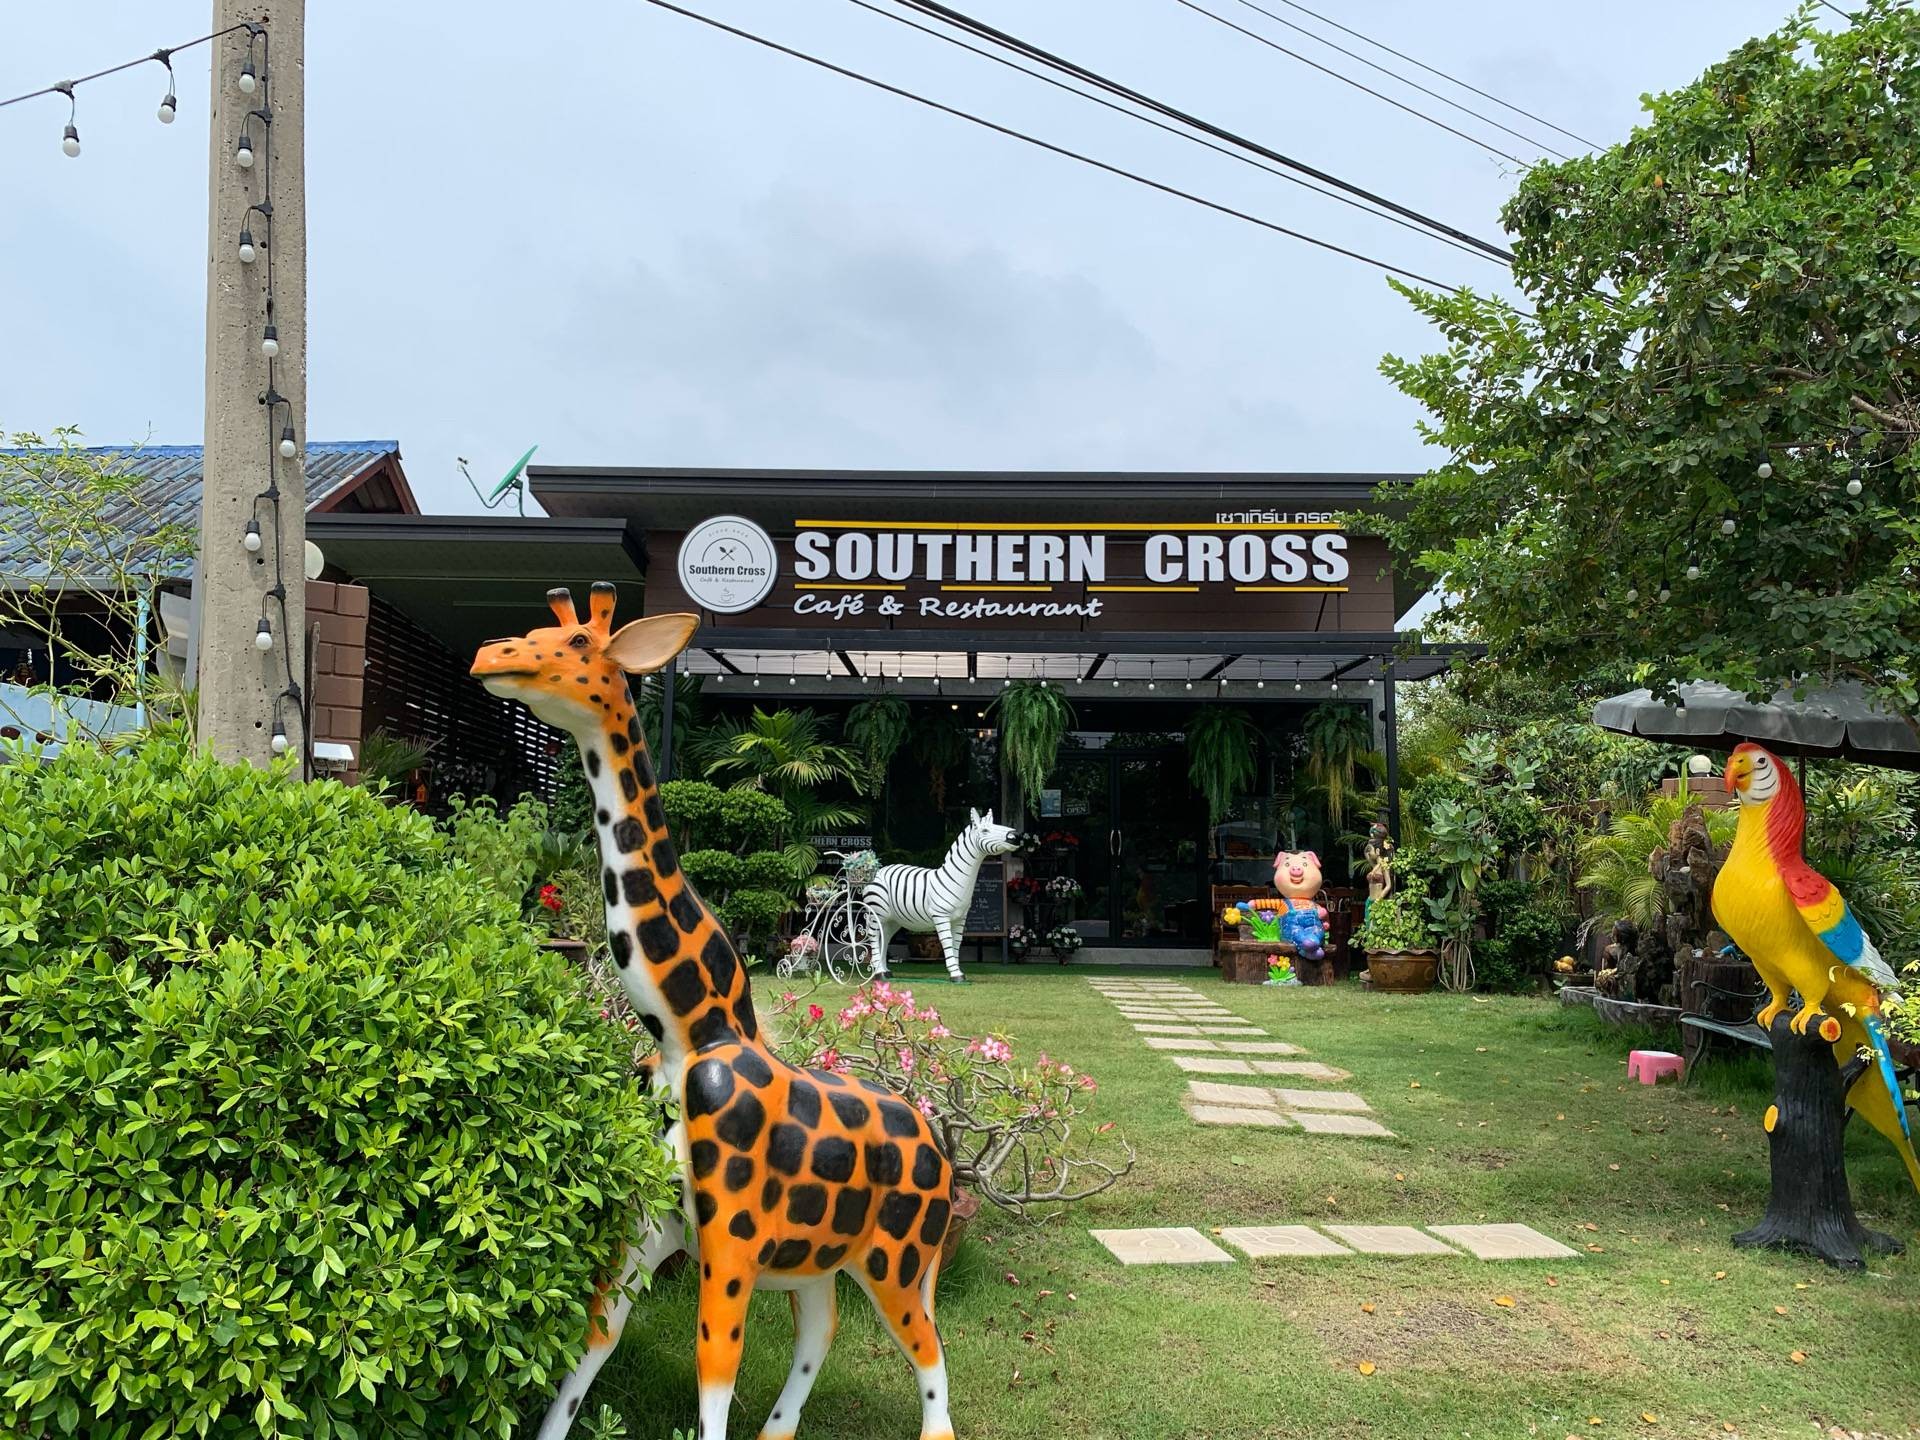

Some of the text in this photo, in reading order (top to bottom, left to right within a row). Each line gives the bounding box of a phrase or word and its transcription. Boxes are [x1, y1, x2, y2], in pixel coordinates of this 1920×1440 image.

[1295, 511, 1340, 524] ครอ
[794, 531, 1349, 583] SOUTHERN CROSS
[689, 564, 766, 576] Southern Cross
[794, 593, 1104, 620] Café & Restaurant
[841, 837, 872, 847] CROSS
